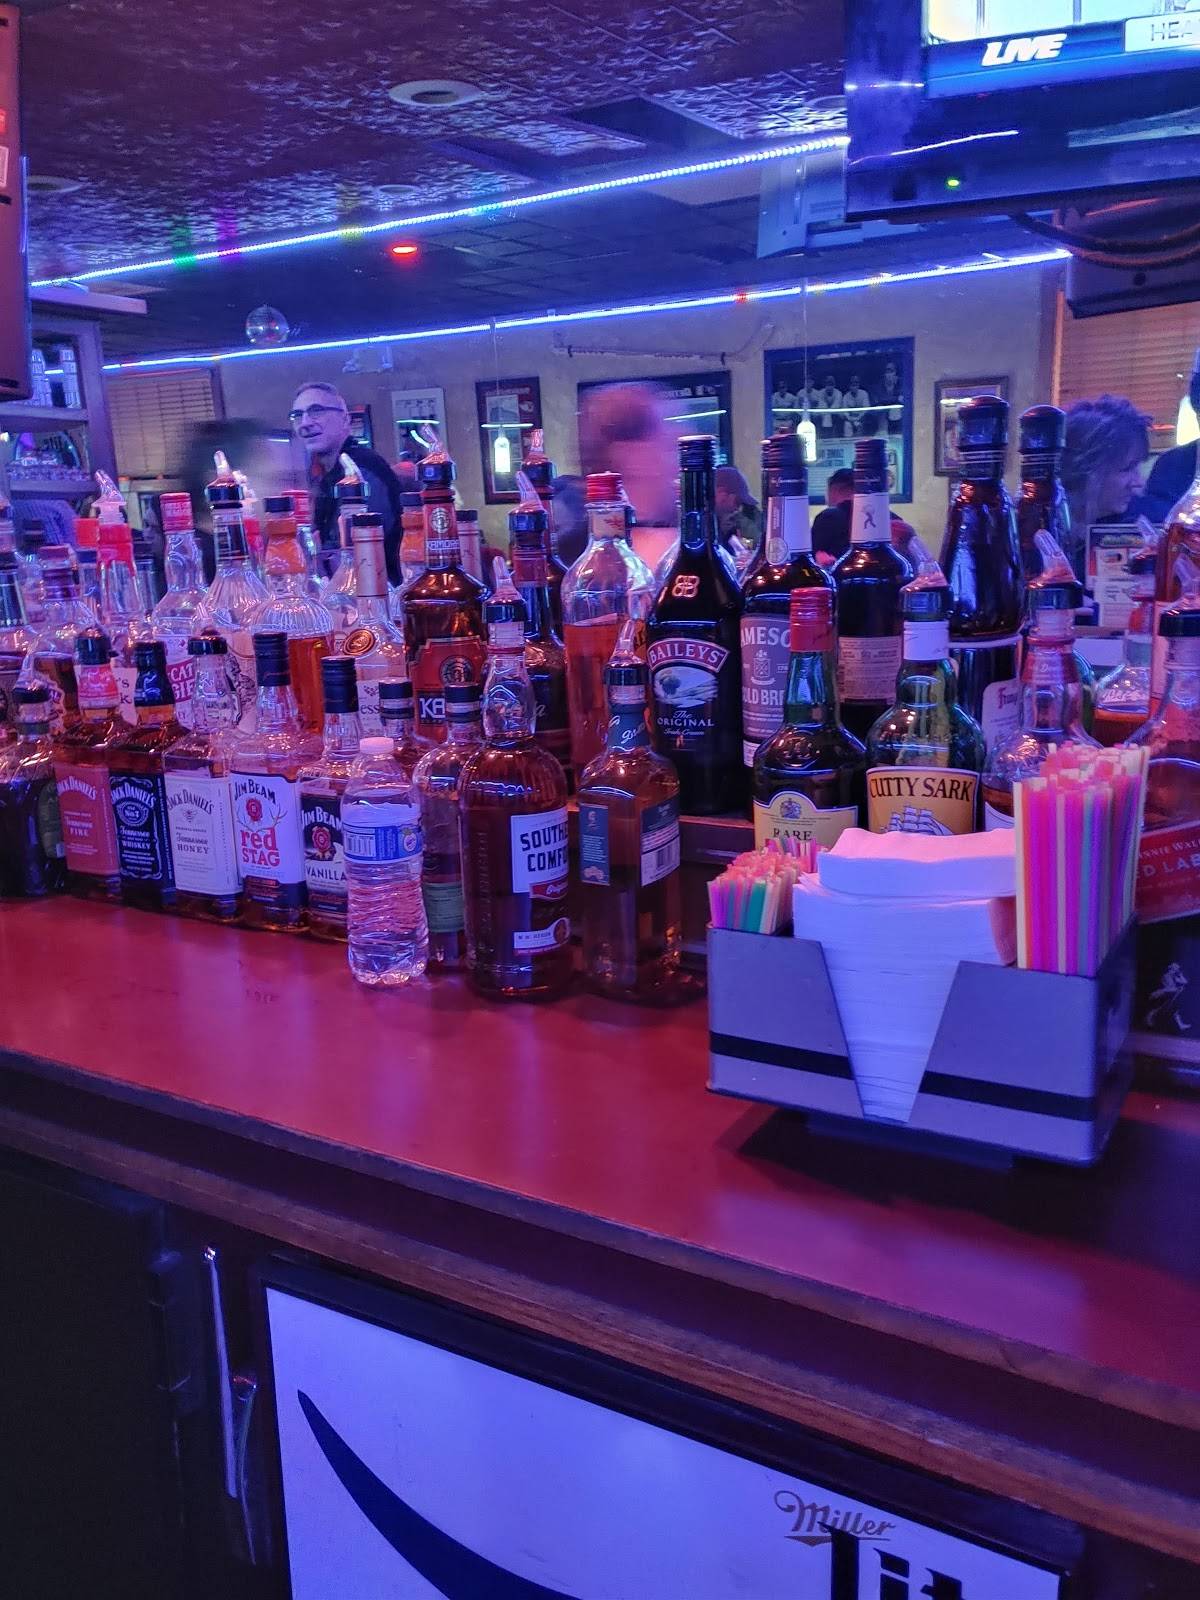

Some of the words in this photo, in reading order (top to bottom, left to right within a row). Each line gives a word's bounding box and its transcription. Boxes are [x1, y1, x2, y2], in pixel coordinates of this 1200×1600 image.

[981, 33, 1068, 67] LIVE
[649, 643, 720, 664] BAILEYS
[657, 717, 715, 727] ORIGINAL
[673, 710, 692, 719] The
[234, 781, 248, 801] JIM
[248, 778, 276, 805] BEAM
[870, 777, 920, 799] CUTTY
[921, 777, 973, 802] SARK
[182, 788, 215, 815] DANIEL'S
[301, 809, 316, 828] JIM
[240, 827, 279, 851] red
[772, 827, 813, 841] RARE
[122, 840, 151, 850] WHISKEY
[177, 843, 209, 854] HONEY
[242, 848, 280, 867] STAG
[305, 864, 347, 881] VANILLA
[774, 1490, 896, 1536] Miller
